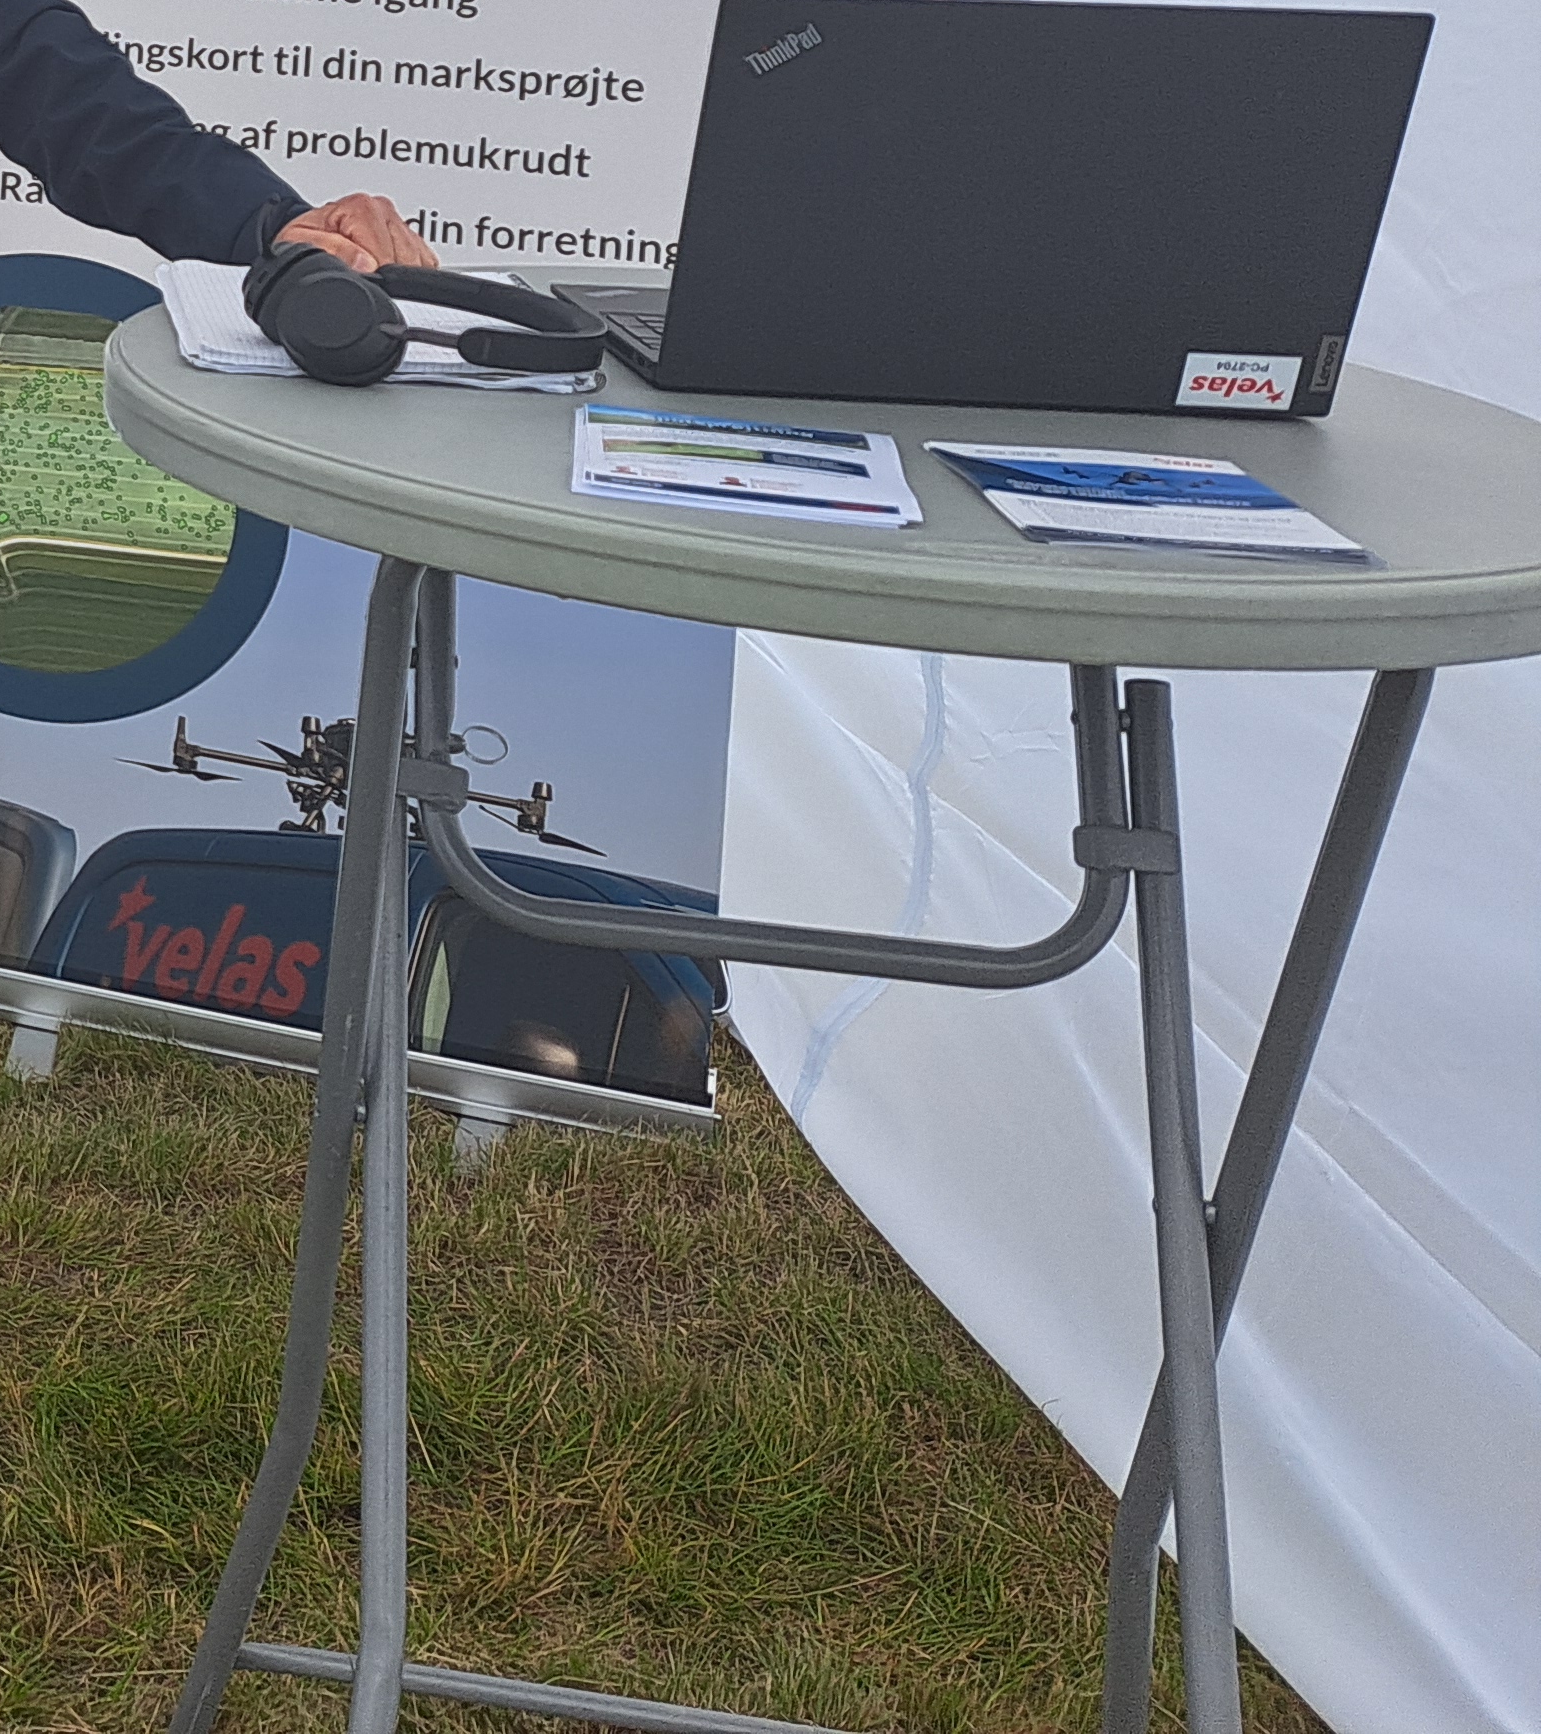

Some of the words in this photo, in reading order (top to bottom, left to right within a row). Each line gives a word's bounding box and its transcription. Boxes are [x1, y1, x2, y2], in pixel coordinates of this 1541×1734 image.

[273, 45, 312, 78] til
[322, 48, 382, 83] din
[394, 58, 645, 107] marksprøjte
[743, 22, 824, 77] ThinkPad
[240, 120, 278, 150] af
[286, 126, 591, 178] problemukrudt
[1188, 375, 1275, 398] velas
[1217, 361, 1269, 373] PC-2704
[120, 904, 322, 1018] velas
